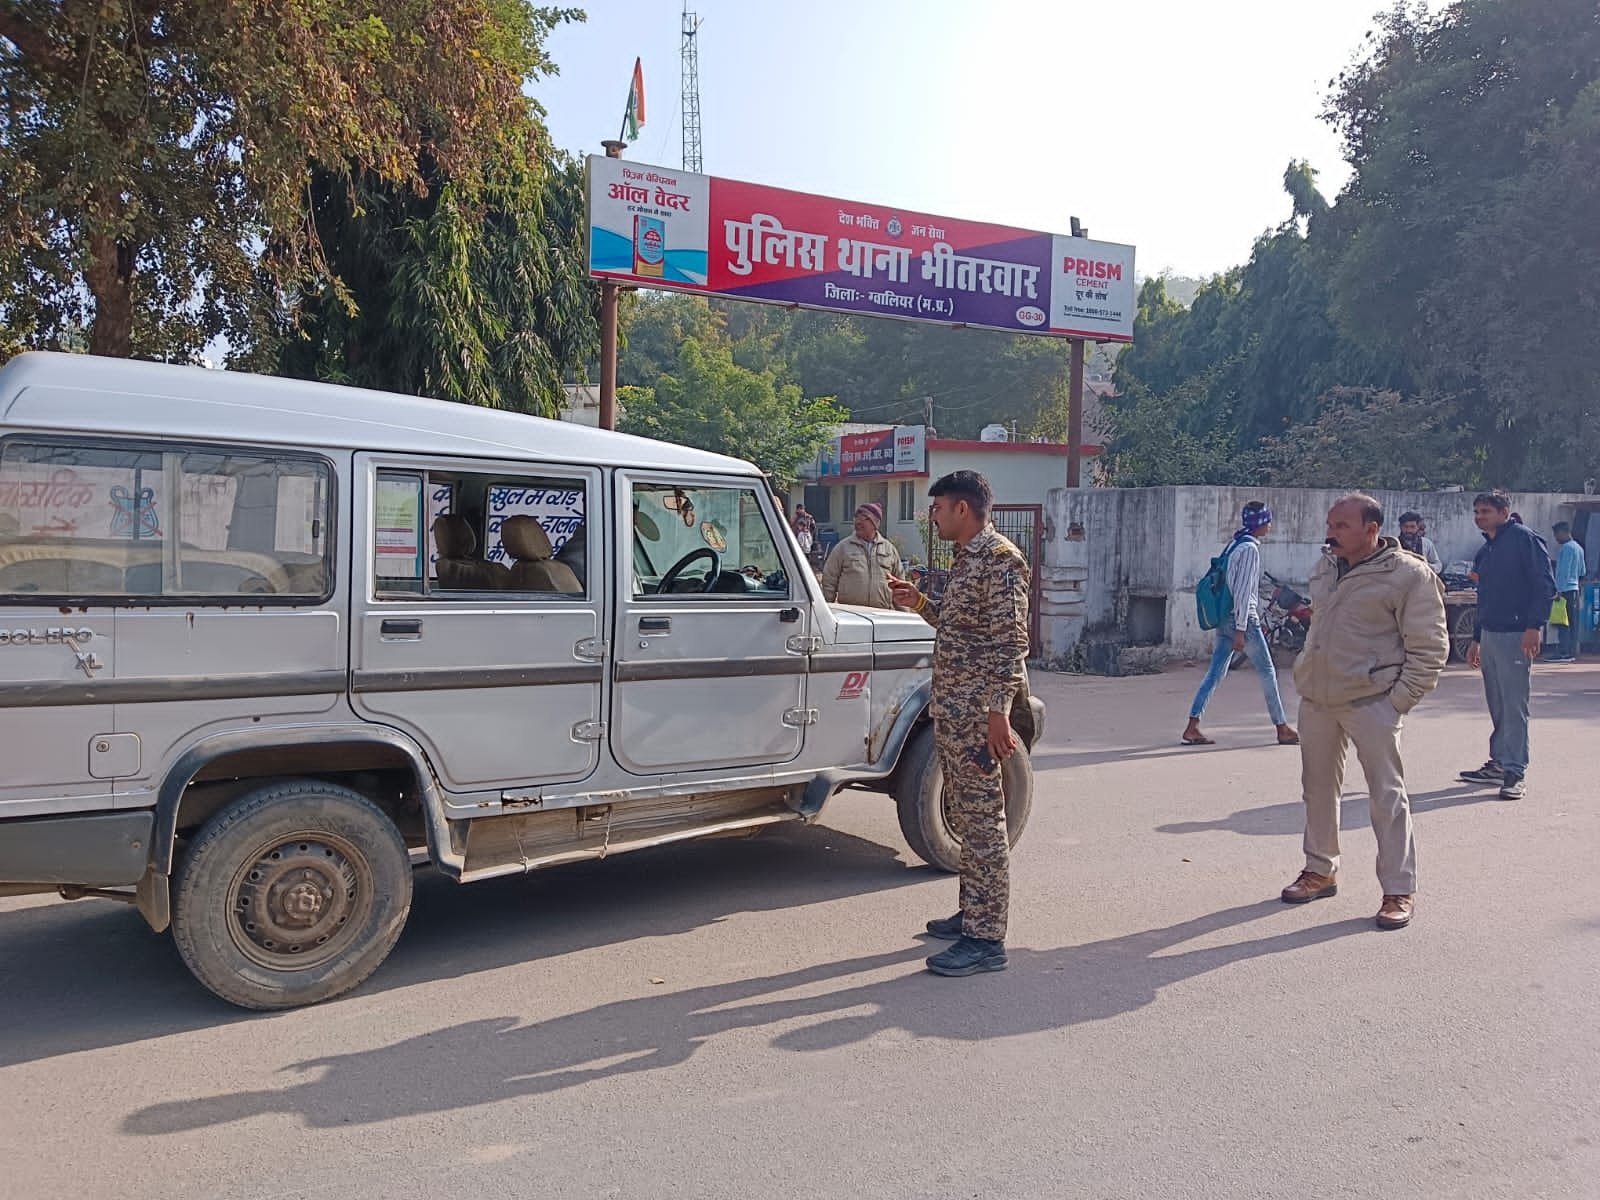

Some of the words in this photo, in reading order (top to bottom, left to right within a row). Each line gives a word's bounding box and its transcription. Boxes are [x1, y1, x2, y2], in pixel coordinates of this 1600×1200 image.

[608, 181, 648, 204] ऑल
[655, 186, 691, 212] वेदर
[839, 210, 853, 225] देश
[856, 214, 880, 230] भक्ति
[911, 224, 926, 237] जन
[928, 225, 945, 240] सेवा
[723, 213, 829, 277] पुलिस
[837, 238, 912, 283] थाना
[921, 242, 1041, 300] भीतरवार
[1063, 256, 1122, 281] PRISM
[1075, 278, 1109, 289] CEMENT
[868, 290, 914, 309] ग्वालियर
[917, 294, 954, 317] (म.प्र.)
[1019, 310, 1043, 322] GG-30
[842, 671, 870, 690] DI
